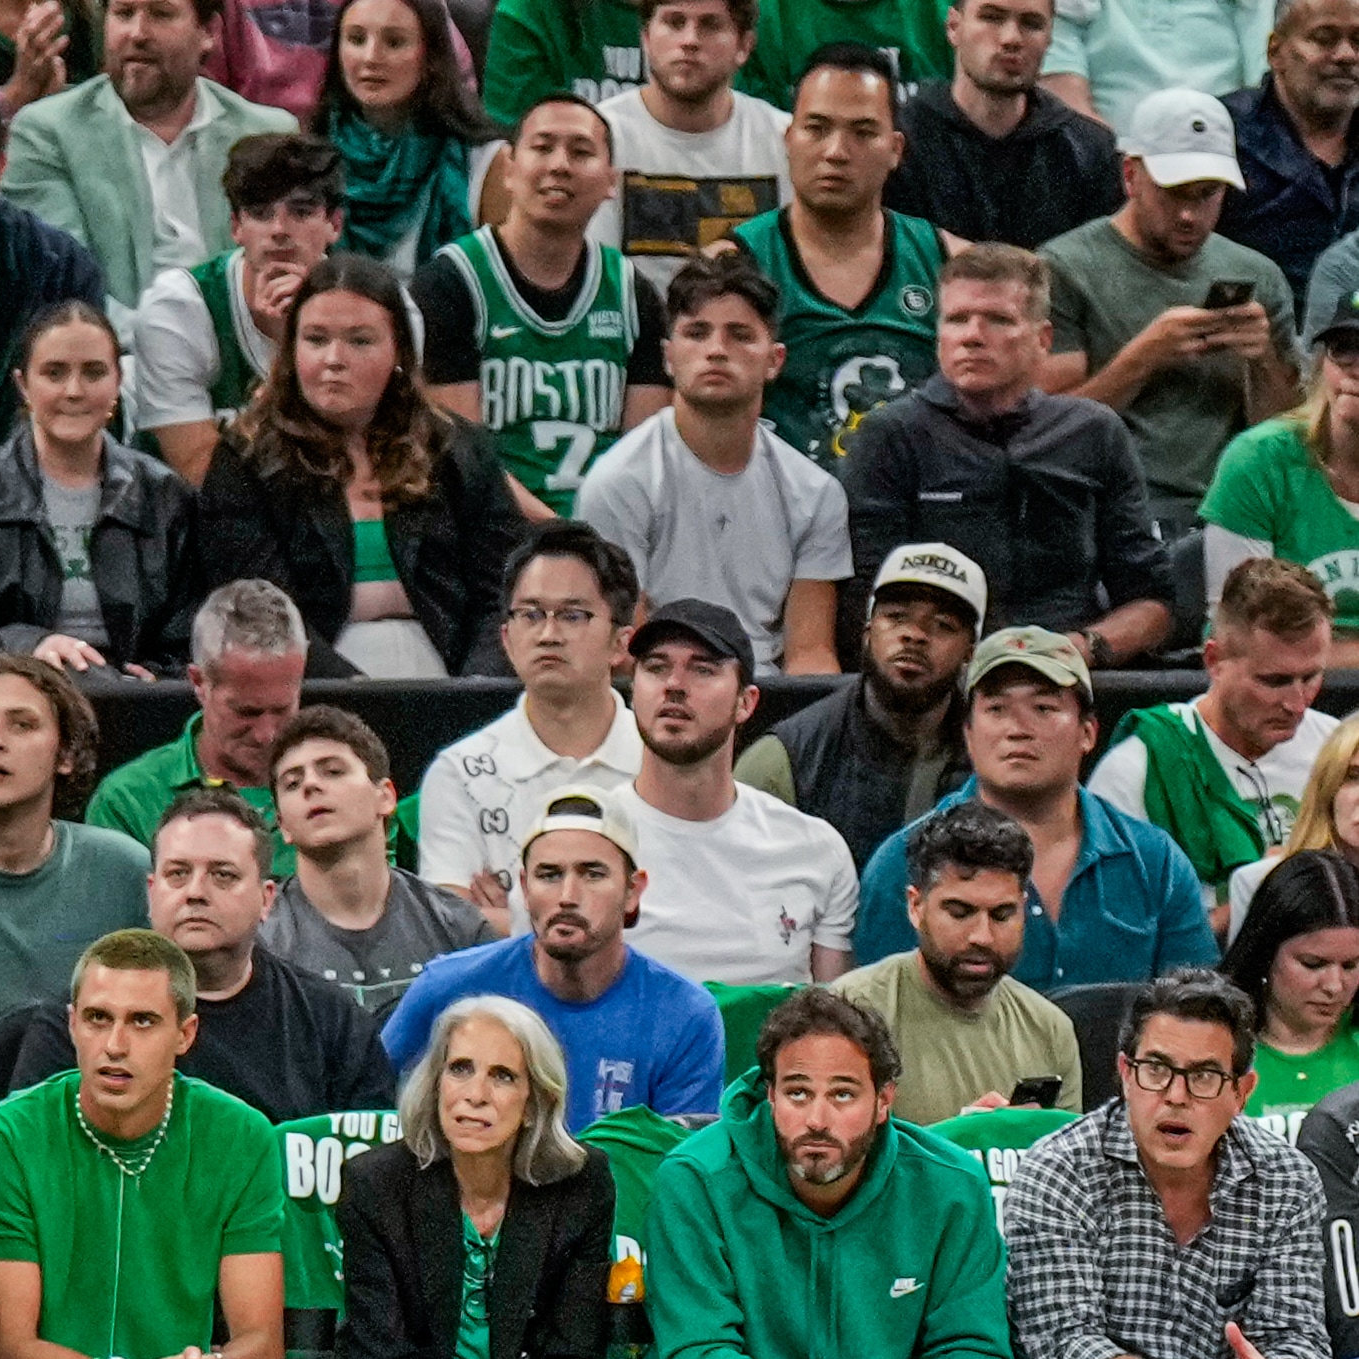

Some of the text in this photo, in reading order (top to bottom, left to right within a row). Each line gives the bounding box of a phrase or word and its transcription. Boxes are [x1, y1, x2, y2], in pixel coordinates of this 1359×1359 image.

[533, 421, 596, 490] 7
[330, 1112, 376, 1142] YOU
[988, 1148, 1028, 1184] GO
